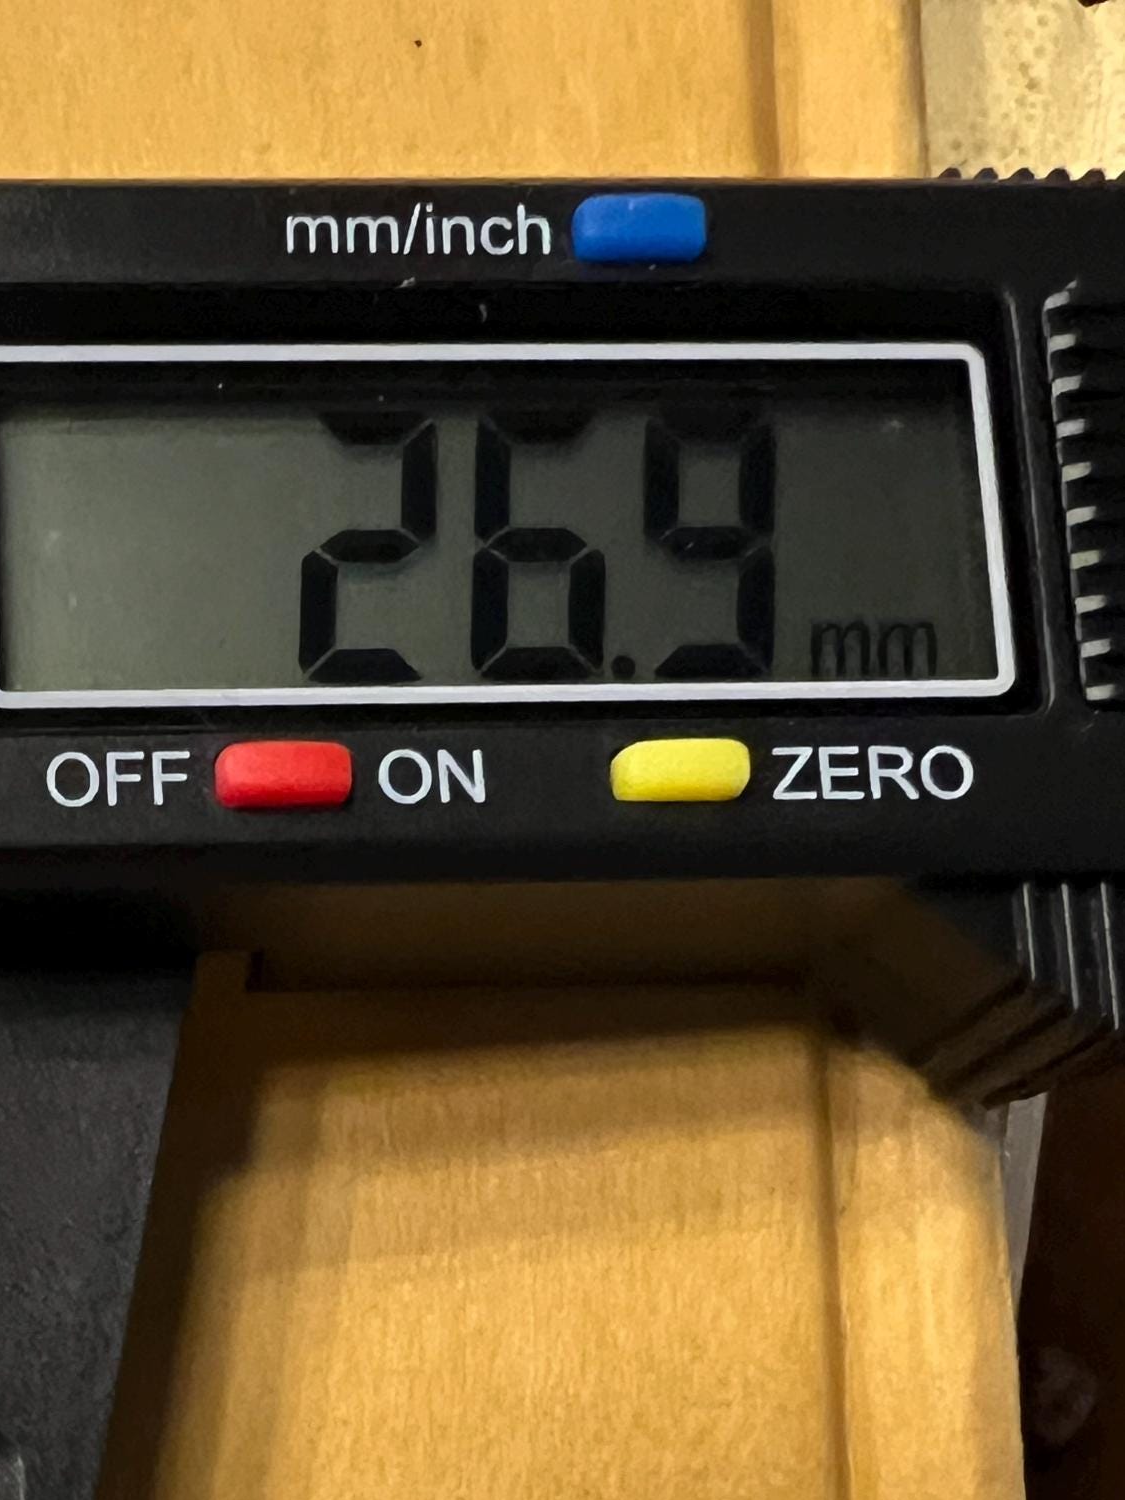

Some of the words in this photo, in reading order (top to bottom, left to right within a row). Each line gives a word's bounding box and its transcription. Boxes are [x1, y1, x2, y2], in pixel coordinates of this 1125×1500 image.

[284, 203, 553, 260] mm/inch
[298, 406, 776, 683] 26.9
[810, 619, 937, 679] mm
[45, 749, 191, 808] OFF
[377, 748, 487, 805] ON
[772, 744, 975, 802] ZERO
